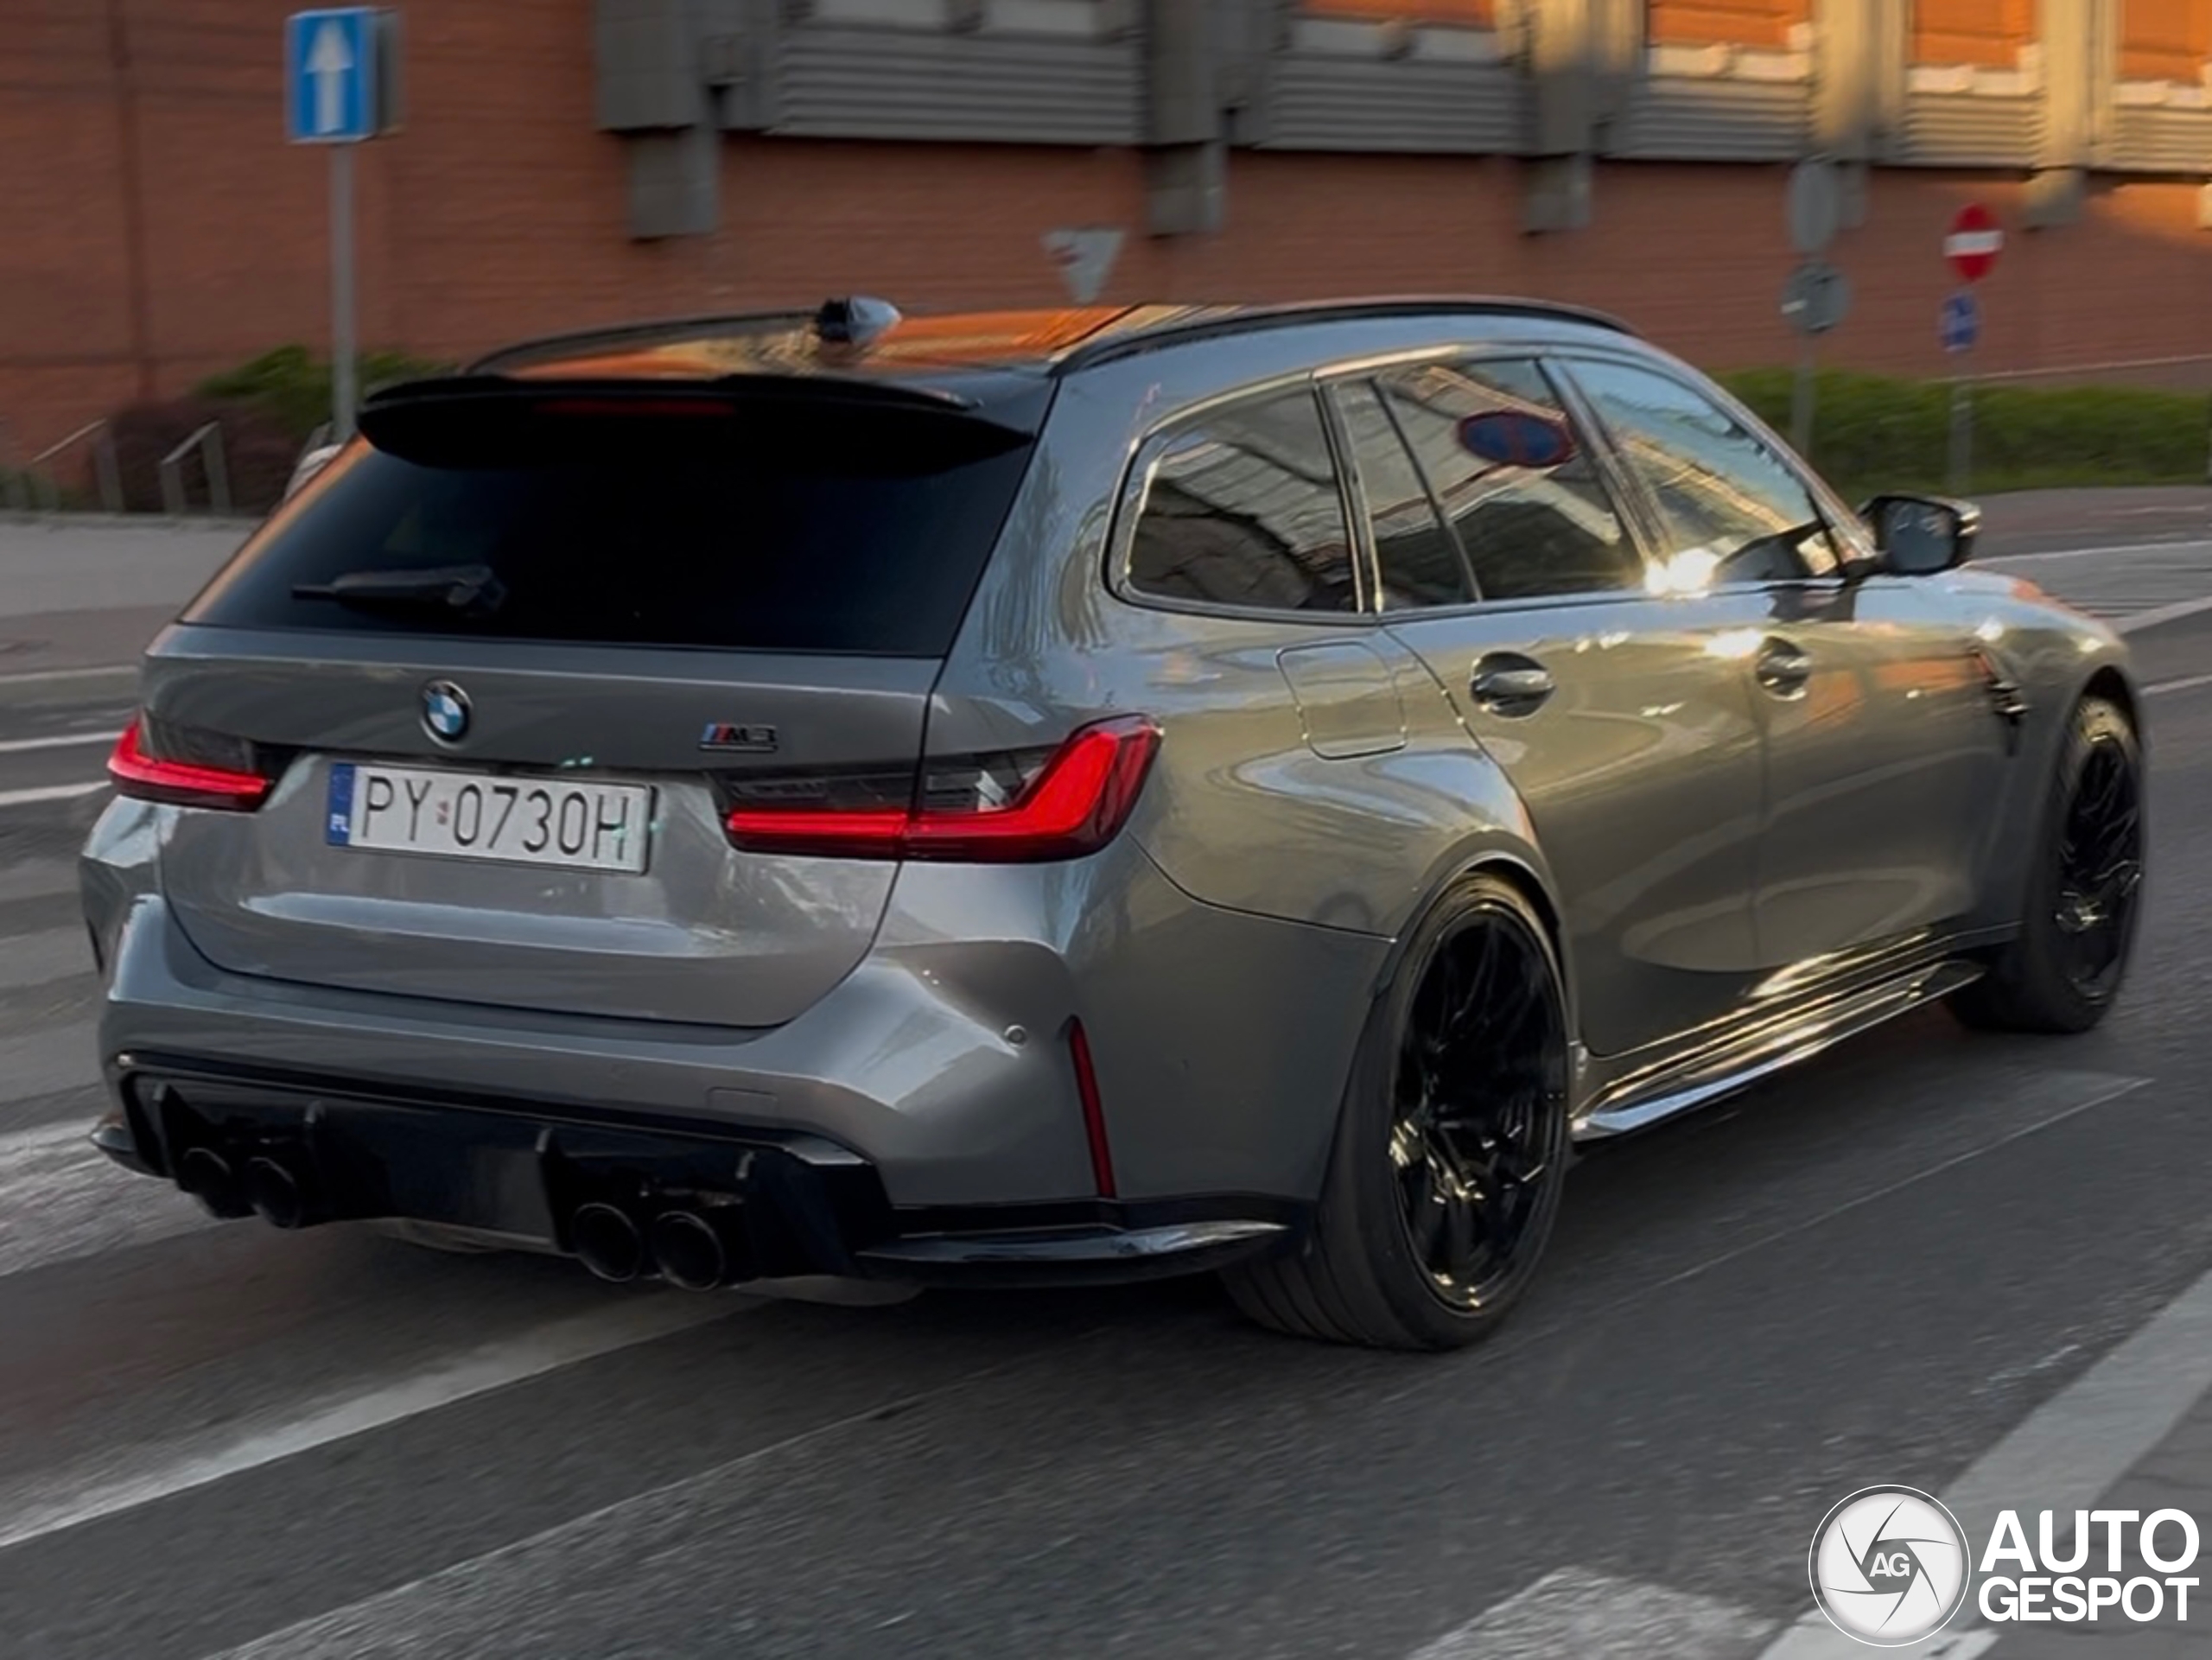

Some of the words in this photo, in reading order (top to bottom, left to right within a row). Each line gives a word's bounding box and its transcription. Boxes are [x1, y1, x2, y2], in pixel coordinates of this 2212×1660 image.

[721, 723, 778, 744] M3
[361, 775, 432, 842] PY
[454, 784, 628, 861] 0730H
